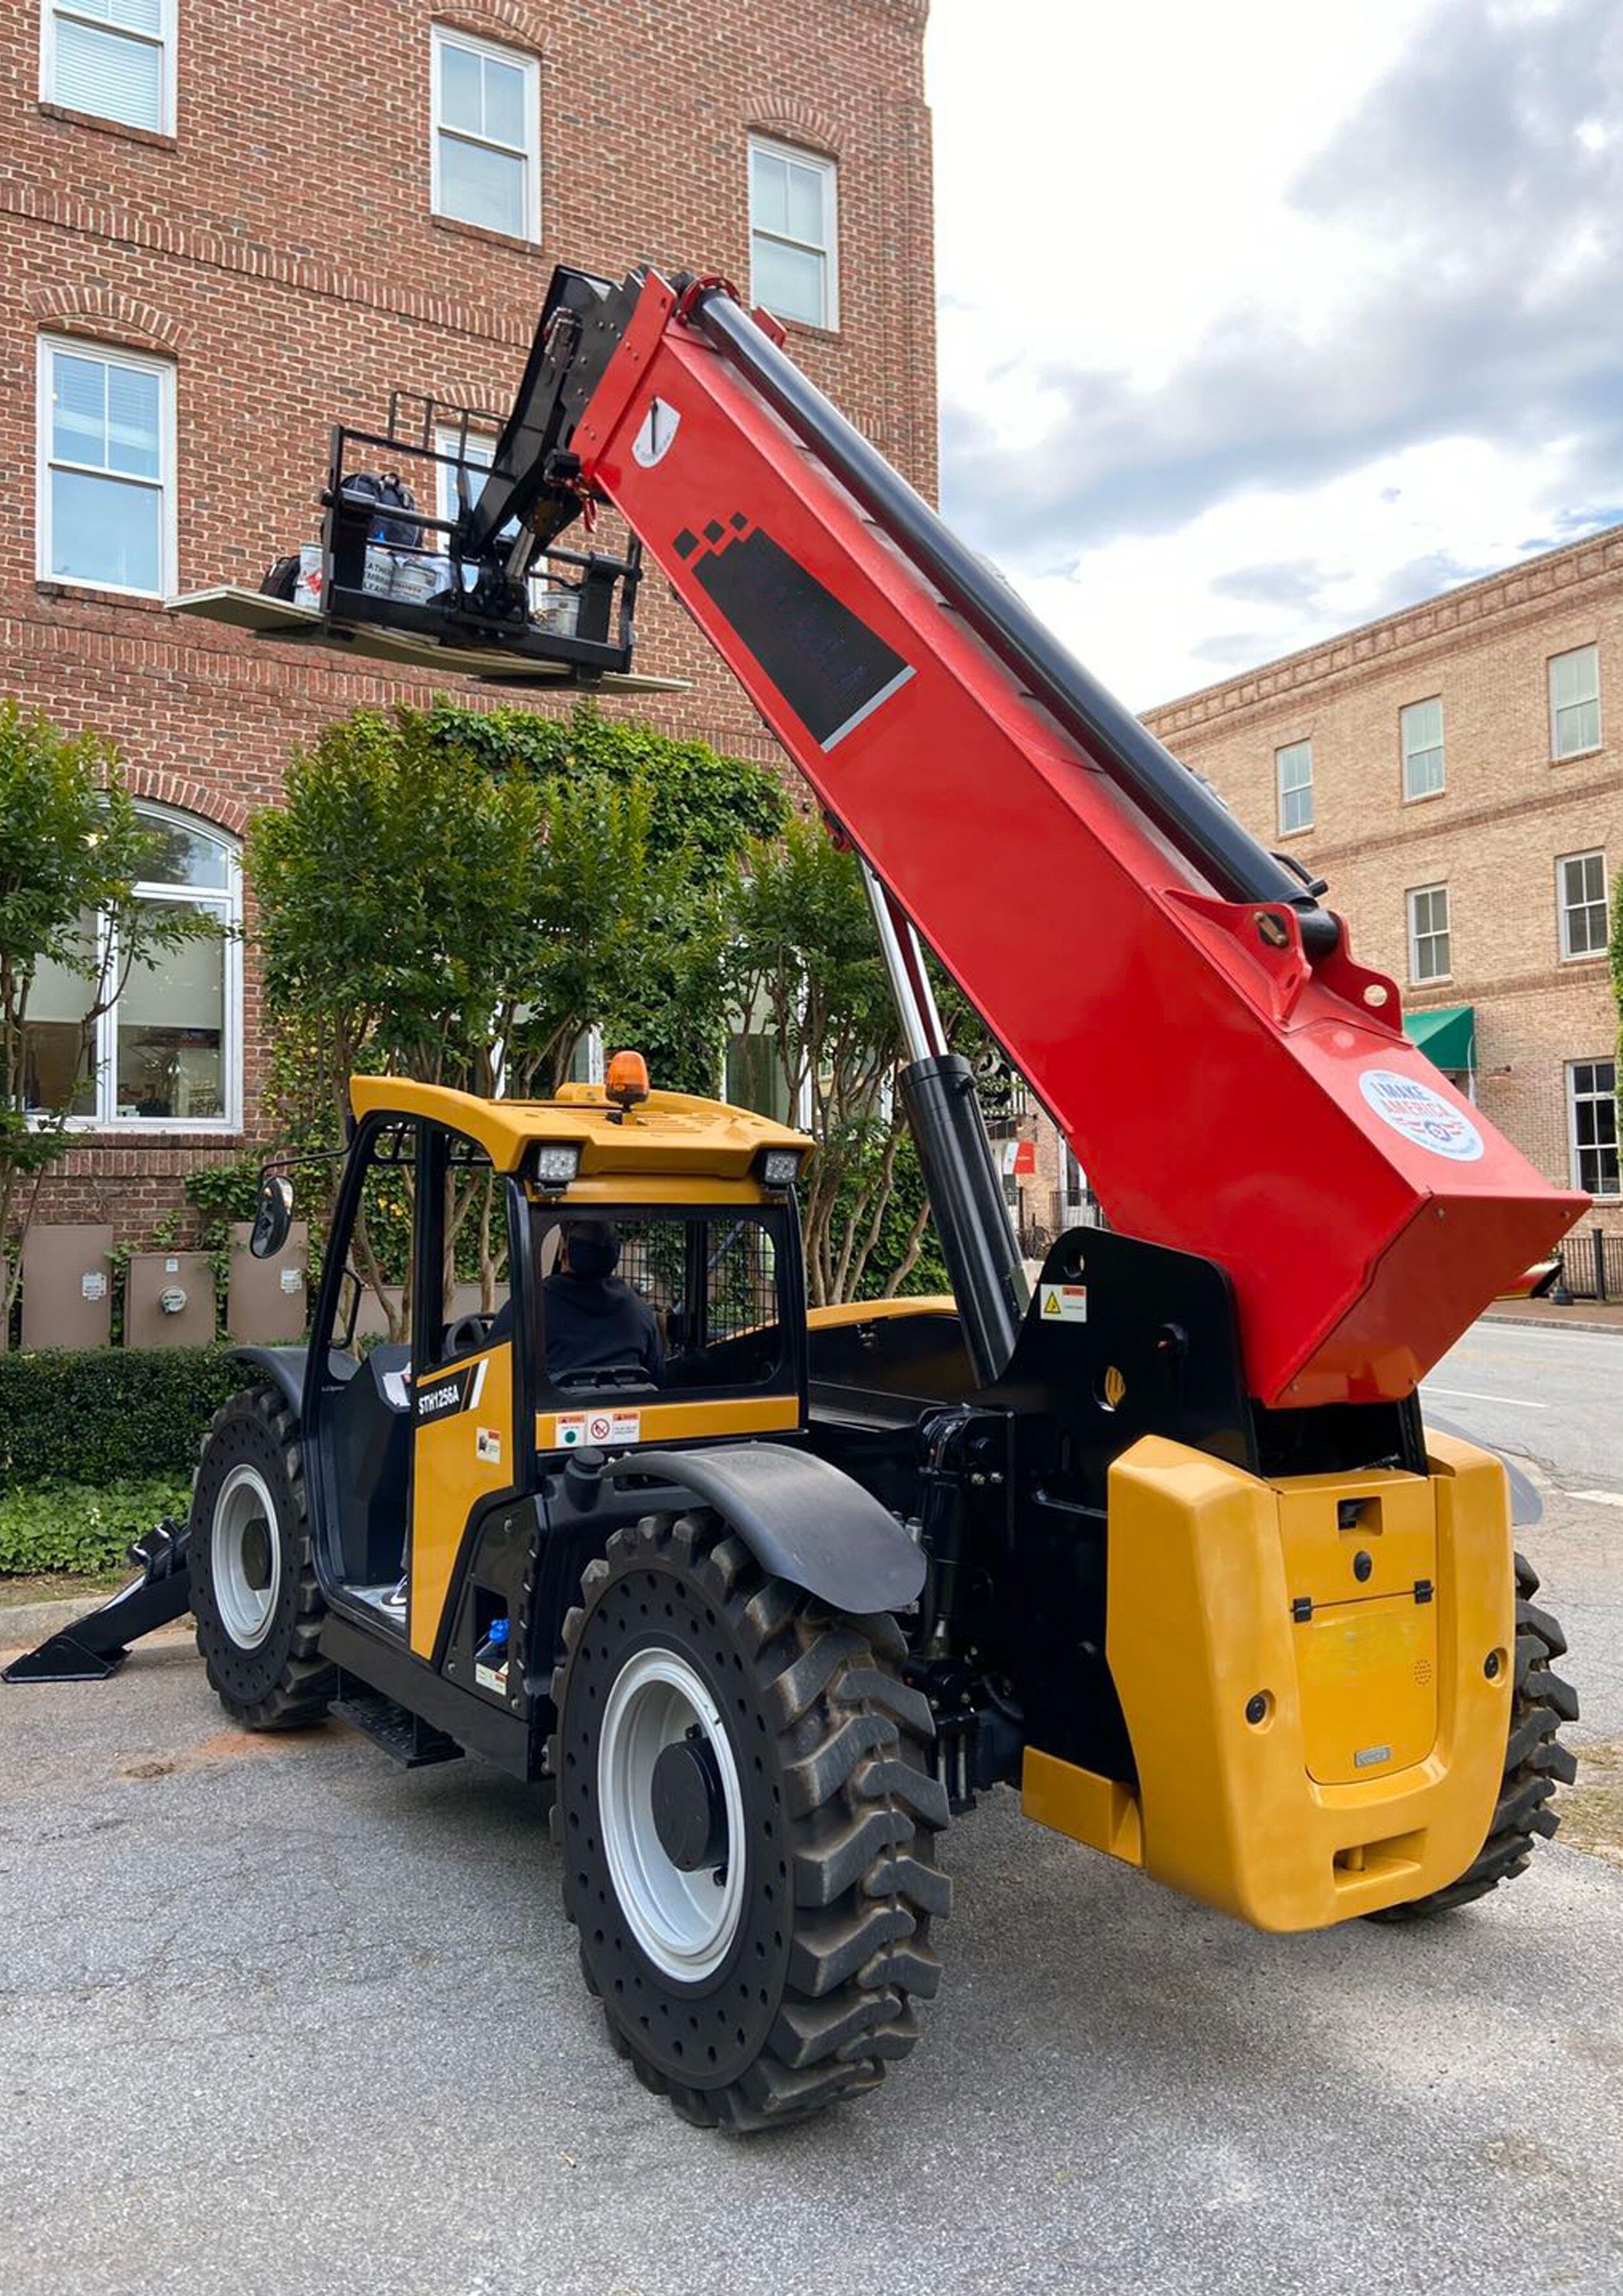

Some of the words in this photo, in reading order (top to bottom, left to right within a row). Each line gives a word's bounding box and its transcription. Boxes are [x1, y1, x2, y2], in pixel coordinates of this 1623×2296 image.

[1377, 1083, 1431, 1100] MAKE
[1380, 1099, 1459, 1118] AMERICA
[418, 1384, 460, 1415] STH1256A
